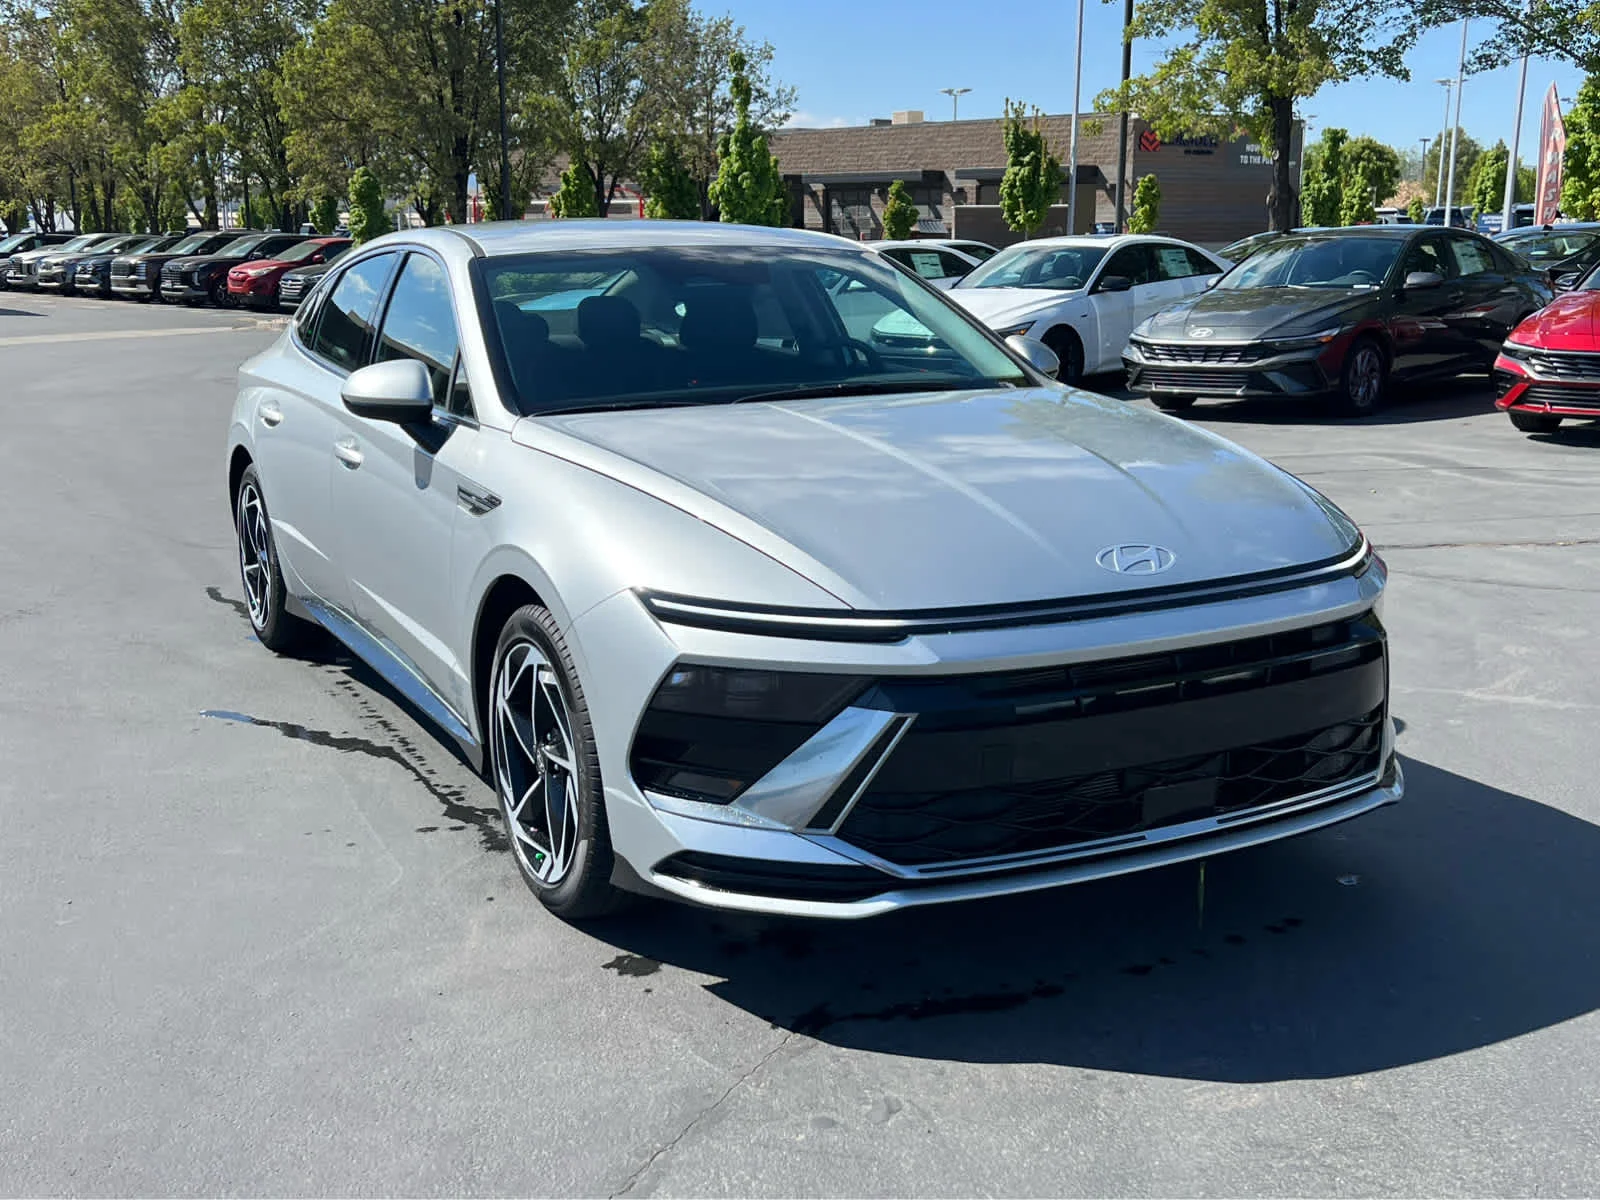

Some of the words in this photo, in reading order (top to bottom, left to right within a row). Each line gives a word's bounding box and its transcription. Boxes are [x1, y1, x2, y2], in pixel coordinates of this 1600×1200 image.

[1240, 154, 1249, 165] TO
[1249, 155, 1261, 165] THE
[1544, 152, 1559, 220] WASH
